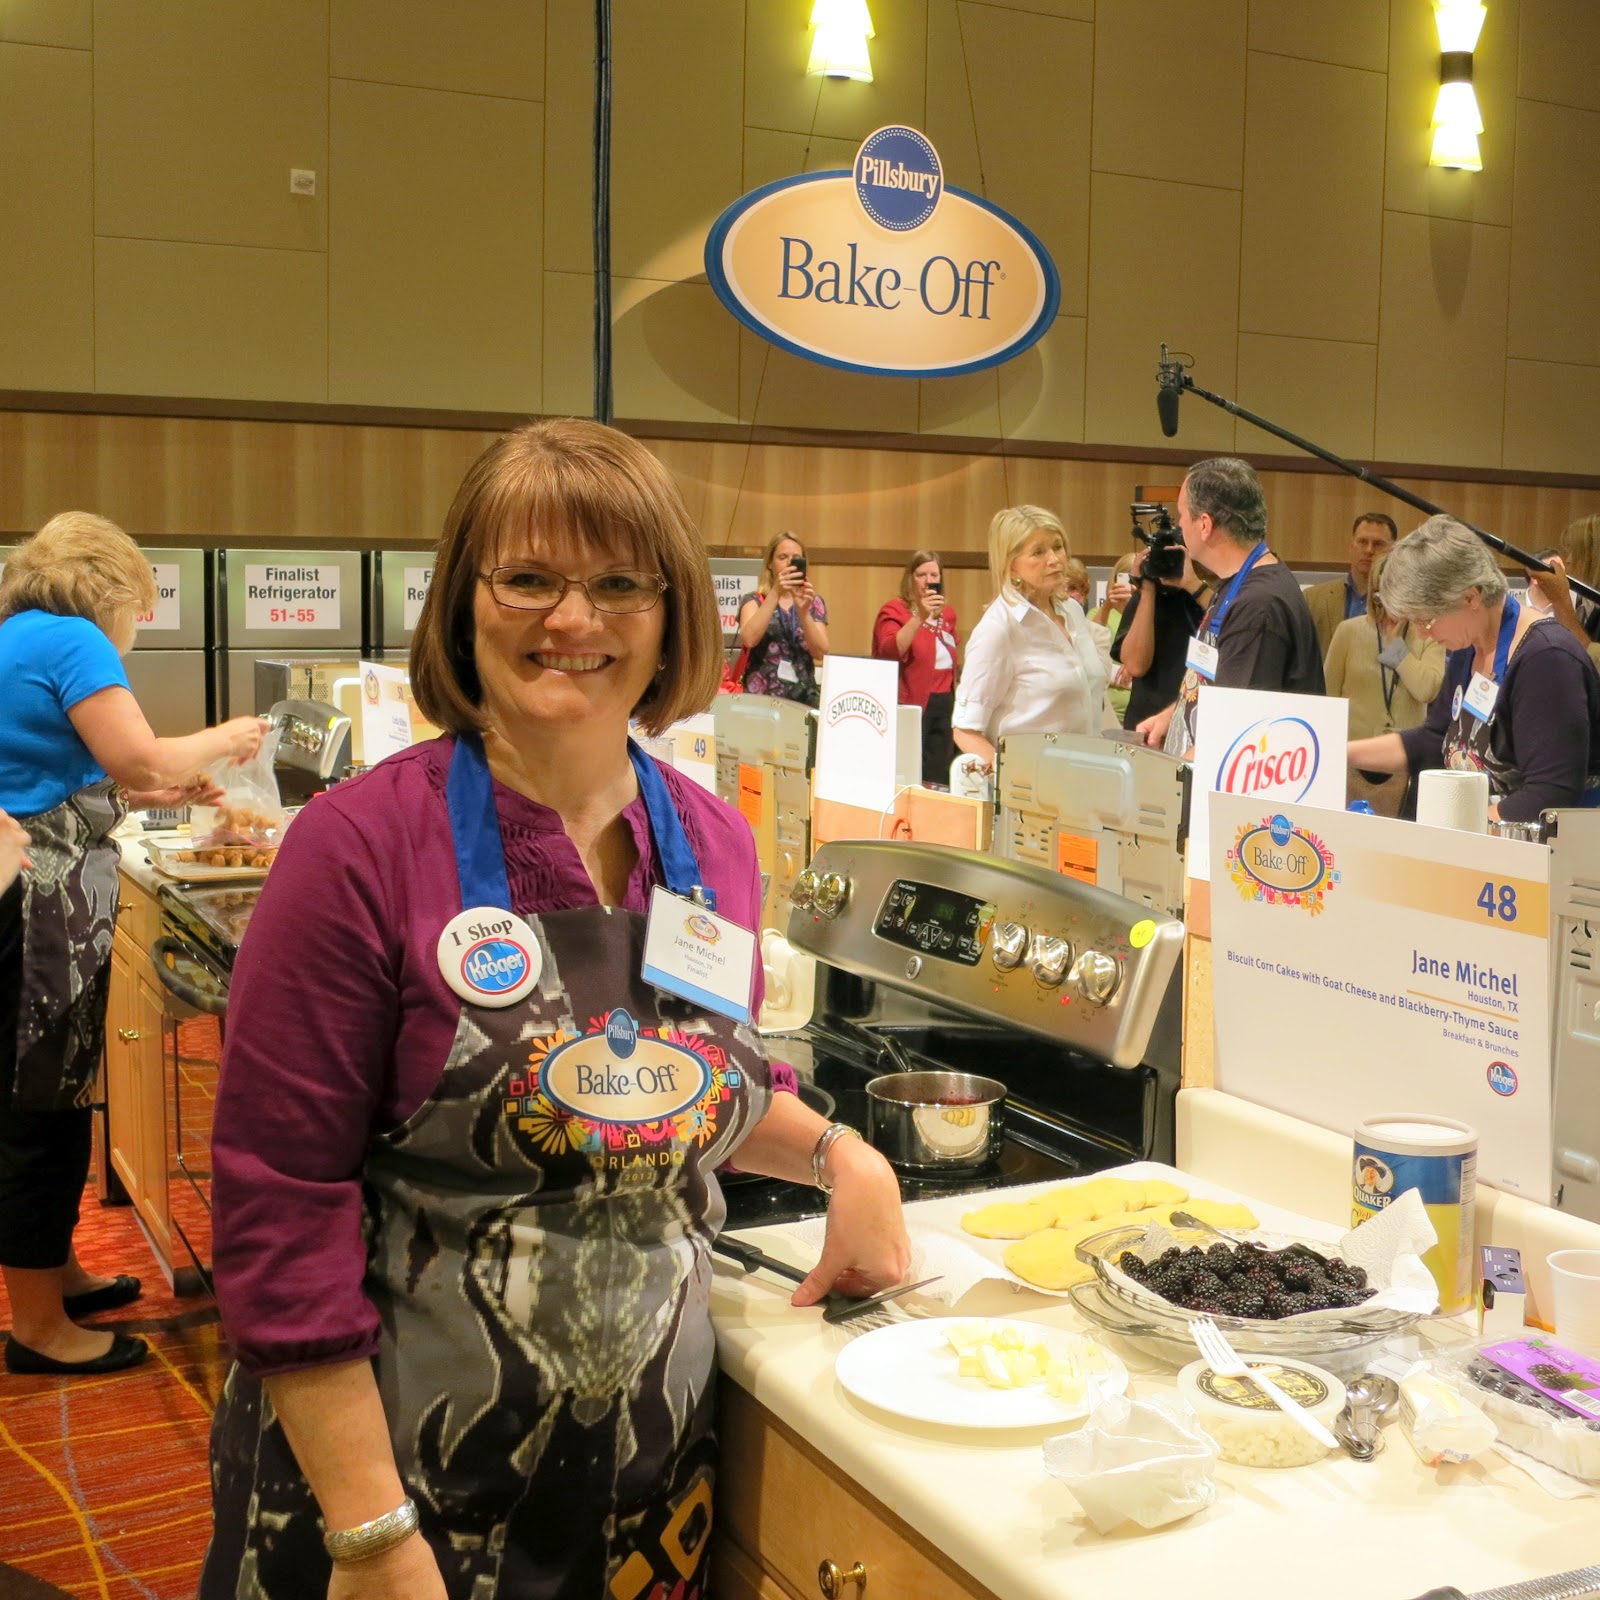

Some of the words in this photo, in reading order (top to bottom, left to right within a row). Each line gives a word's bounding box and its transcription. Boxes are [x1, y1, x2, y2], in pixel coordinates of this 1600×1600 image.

[860, 156, 939, 199] Pillsbury
[265, 568, 320, 582] Finalist
[714, 577, 741, 590] alist
[249, 585, 336, 602] Refrigerator
[270, 608, 315, 622] 51-55
[831, 696, 884, 727] SMUCKER'S
[694, 737, 706, 758] 49
[1225, 744, 1307, 794] Crisco
[1253, 846, 1307, 875] Bake-Off
[1477, 881, 1517, 922] 48
[450, 930, 463, 947] I
[468, 919, 513, 941] Shop
[674, 935, 694, 952] Jane
[696, 945, 726, 966] Michel
[467, 949, 523, 986] Kroger
[1412, 949, 1450, 979] Jane
[1455, 960, 1518, 998] Michel
[1227, 950, 1254, 967] Biscuit
[1255, 958, 1274, 972] Corn
[1276, 963, 1300, 980] Cakes
[1302, 971, 1320, 985] with
[1323, 976, 1343, 991] Goat
[1345, 982, 1377, 1000] Cheese
[1379, 993, 1396, 1006] and
[1399, 996, 1485, 1030] Blackberry-Thyme
[1488, 1021, 1519, 1040] Sauce
[1467, 990, 1505, 1011] Houston,
[1508, 1000, 1518, 1013] TX
[607, 1023, 636, 1045] Pillsbury
[1442, 1028, 1476, 1046] Breakfast
[1477, 1039, 1483, 1048] &
[1485, 1040, 1519, 1058] Brunches
[575, 1063, 677, 1096] Bake-Off
[1490, 1065, 1516, 1092] Kroger
[591, 1150, 686, 1170] ORLANDO
[624, 1172, 653, 1182] 2012
[1353, 1185, 1391, 1208] QUAKER
